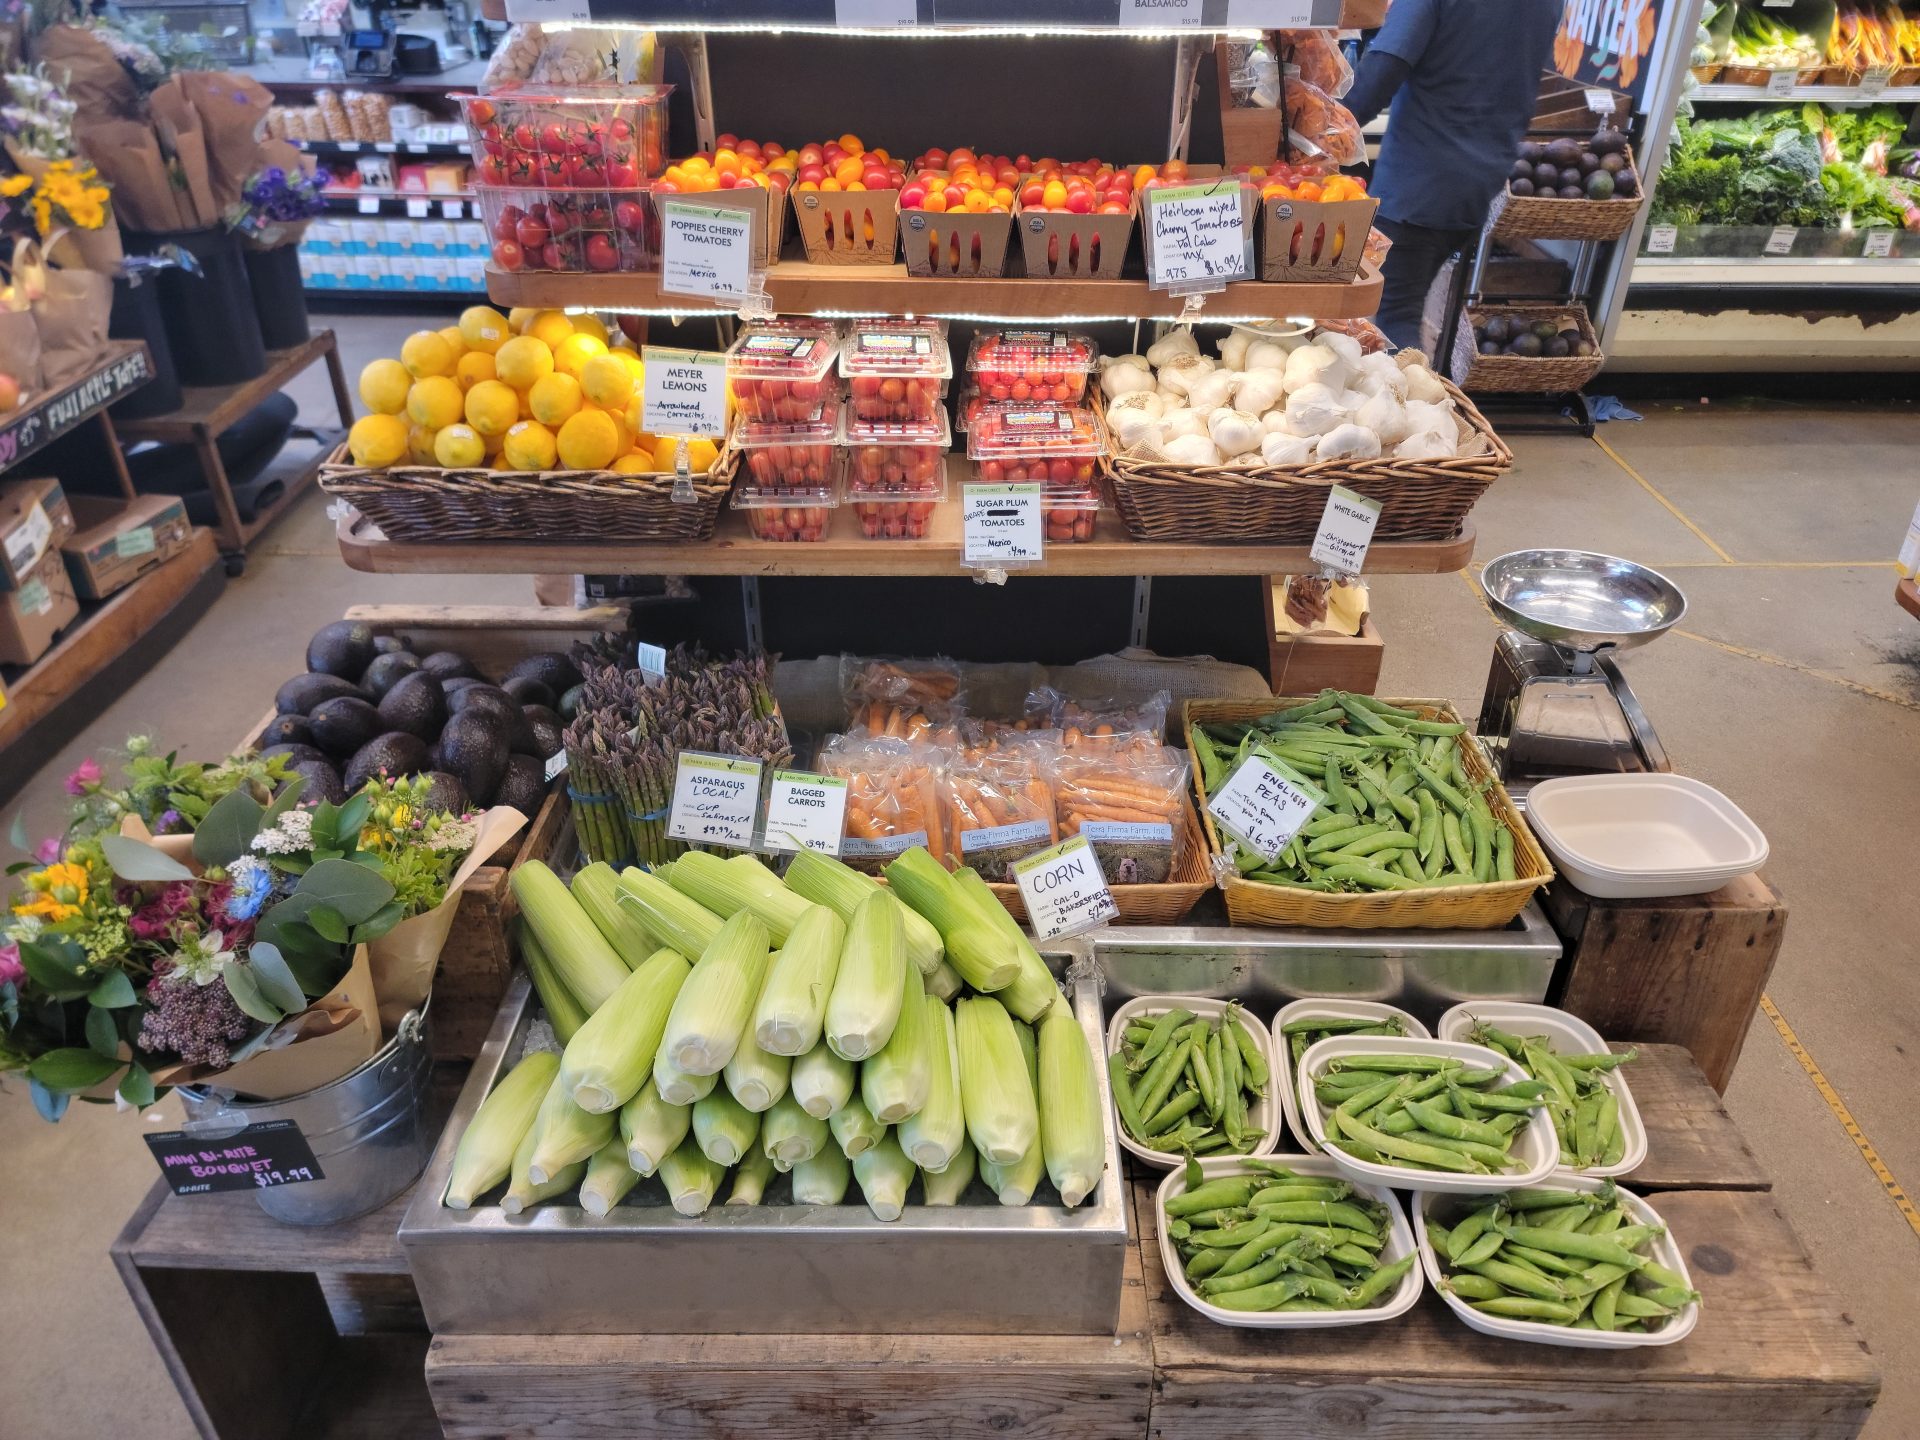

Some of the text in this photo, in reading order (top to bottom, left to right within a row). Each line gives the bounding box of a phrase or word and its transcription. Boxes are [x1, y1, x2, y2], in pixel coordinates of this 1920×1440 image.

[1160, 194, 1237, 219] Heirloom mixed
[671, 221, 744, 237] POPPIES CHERRY
[1156, 220, 1189, 239] Cherry
[682, 233, 732, 247] TOMATOES
[689, 269, 717, 278] Mexico
[1166, 267, 1187, 280] 975
[667, 368, 703, 379] MEYER
[663, 381, 707, 392] LEMONS
[657, 401, 700, 410] Arrowhead
[976, 499, 1029, 508] SUGAR PLUM
[964, 509, 985, 522] GRAPE
[1334, 503, 1372, 523] WHITE GARLIC
[980, 519, 1025, 527] TOMATOES
[987, 539, 1011, 547] Mexico
[1008, 546, 1026, 557] $4.99
[690, 776, 745, 790] ASPARAGUS
[1262, 771, 1307, 808] ENGLISH
[693, 786, 738, 800] LOCAL!
[791, 787, 825, 798] BAGGED
[1255, 783, 1287, 811] PEAS
[788, 797, 825, 808] CARROTS
[1086, 825, 1105, 833] Terra
[1033, 858, 1085, 893] CORN
[1059, 888, 1111, 915] BAKERSFIELD
[164, 1145, 258, 1168] MINI BI-RITE
[191, 1158, 314, 1188] BOUQUET $19.99
[179, 1184, 211, 1193] BI-RITE
